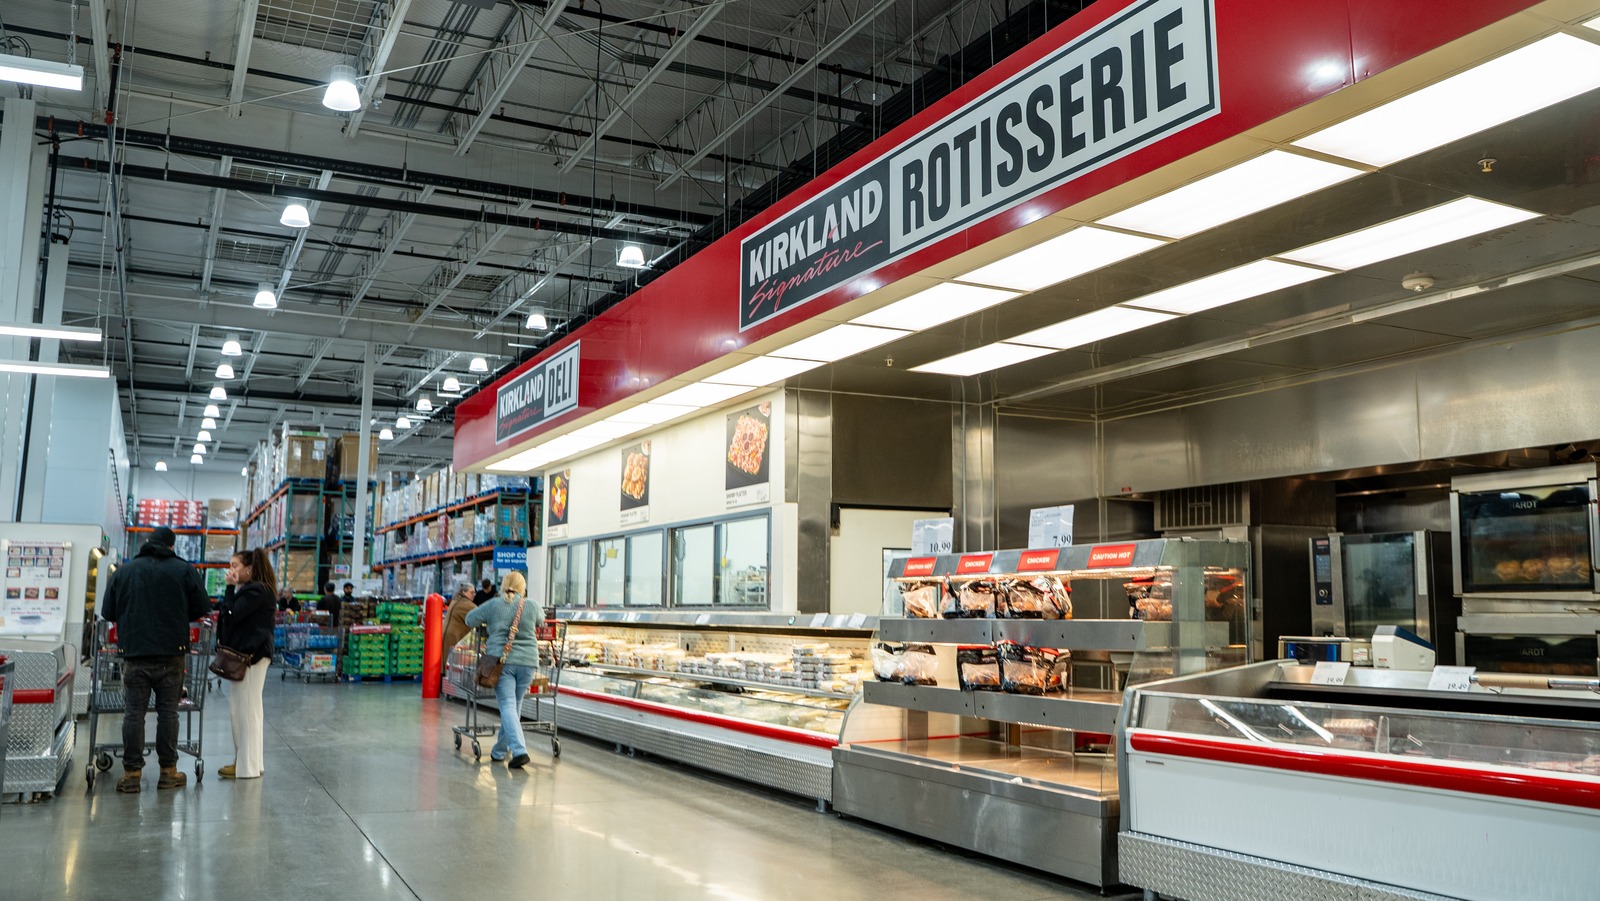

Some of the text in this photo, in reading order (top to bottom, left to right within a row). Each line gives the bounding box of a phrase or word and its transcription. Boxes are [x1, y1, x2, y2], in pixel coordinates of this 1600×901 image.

[902, 6, 1187, 236] ROTISSERIE
[749, 179, 883, 287] KIRKLAND
[749, 240, 883, 319] Signature
[547, 357, 573, 409] DELI
[499, 373, 544, 419] KIRKLAND
[498, 406, 543, 438] Signature
[930, 542, 951, 553] 10.99
[1052, 534, 1072, 547] 7.99
[964, 560, 986, 568] CHICKEN
[1026, 556, 1051, 564] CHICKEN
[1092, 551, 1131, 561] CAUTION HOT
[1522, 647, 1545, 656] ARDT
